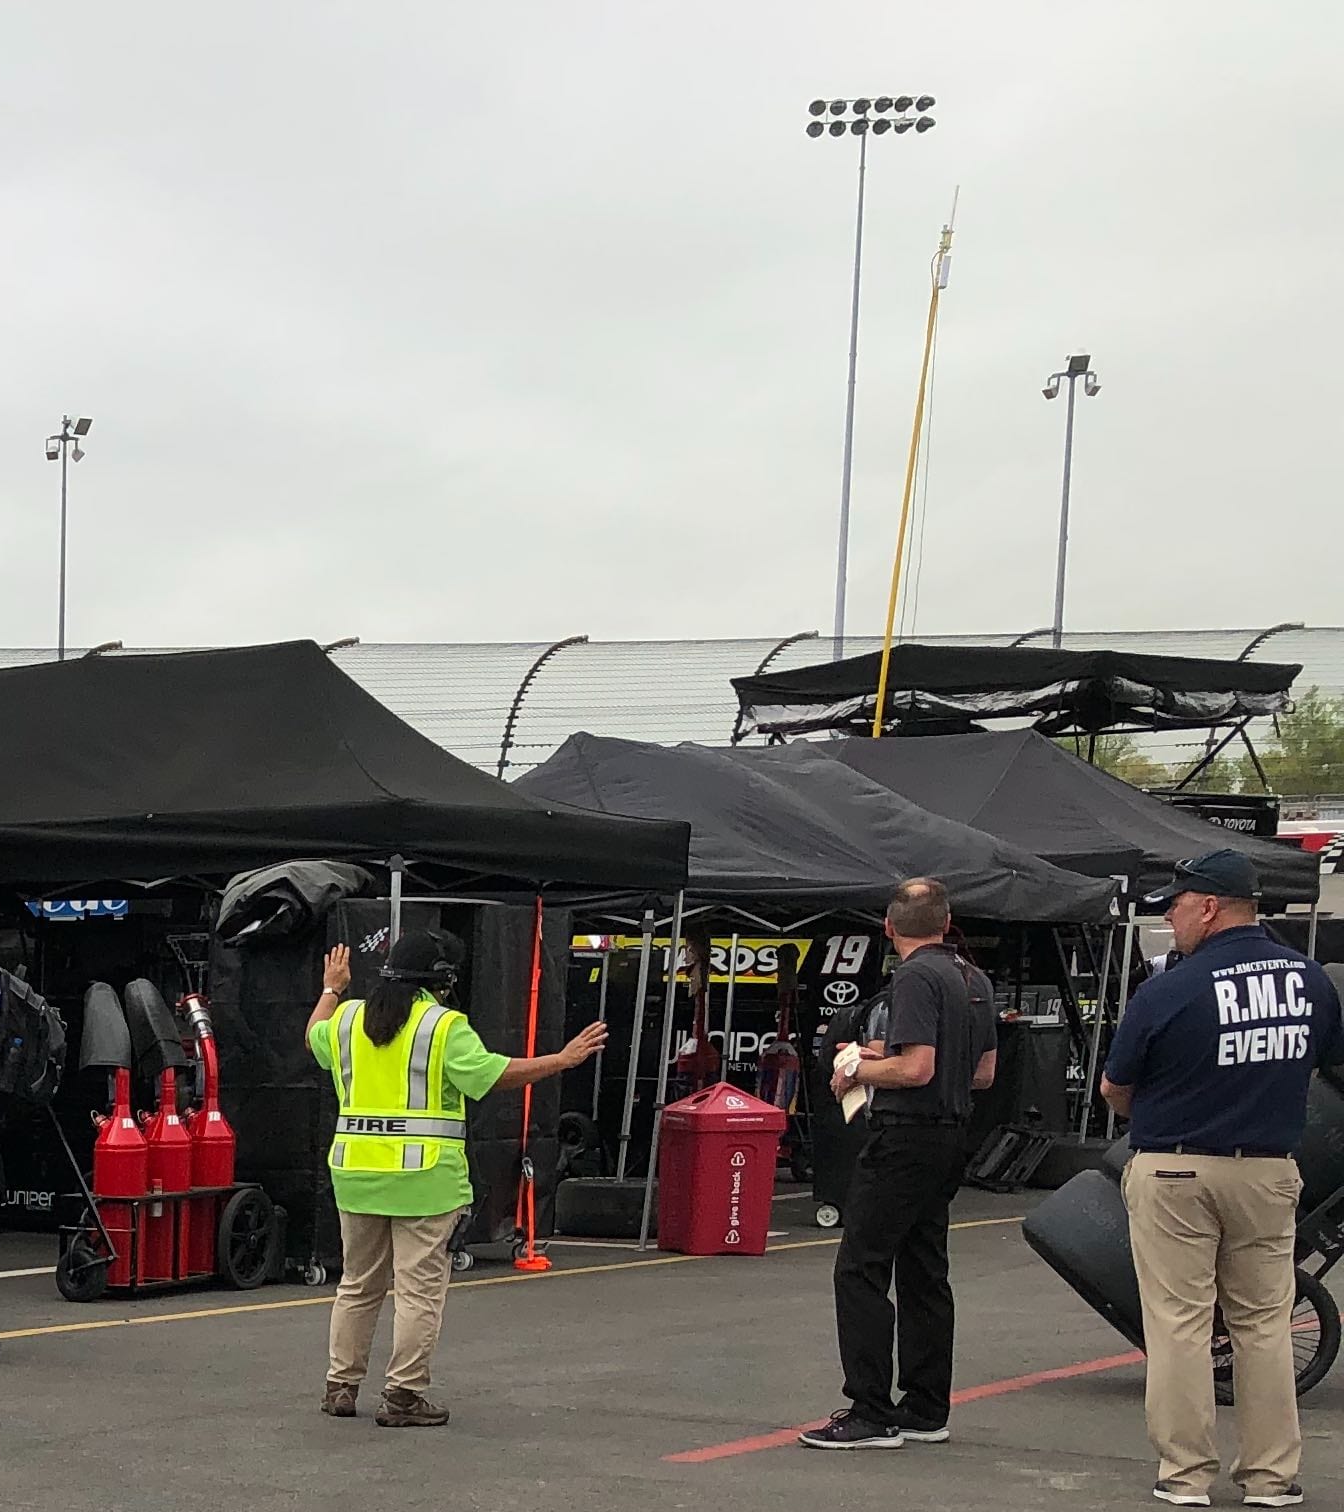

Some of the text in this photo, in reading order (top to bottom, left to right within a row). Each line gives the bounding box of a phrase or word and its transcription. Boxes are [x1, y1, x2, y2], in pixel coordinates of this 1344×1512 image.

[1223, 818, 1256, 831] TOYOTA
[820, 935, 870, 974] 19
[1214, 971, 1313, 1025] R.M.C.
[1218, 1024, 1311, 1066] EVENTS
[345, 1118, 408, 1133] FIRE
[730, 1171, 742, 1194] back
[729, 1206, 740, 1227] give
